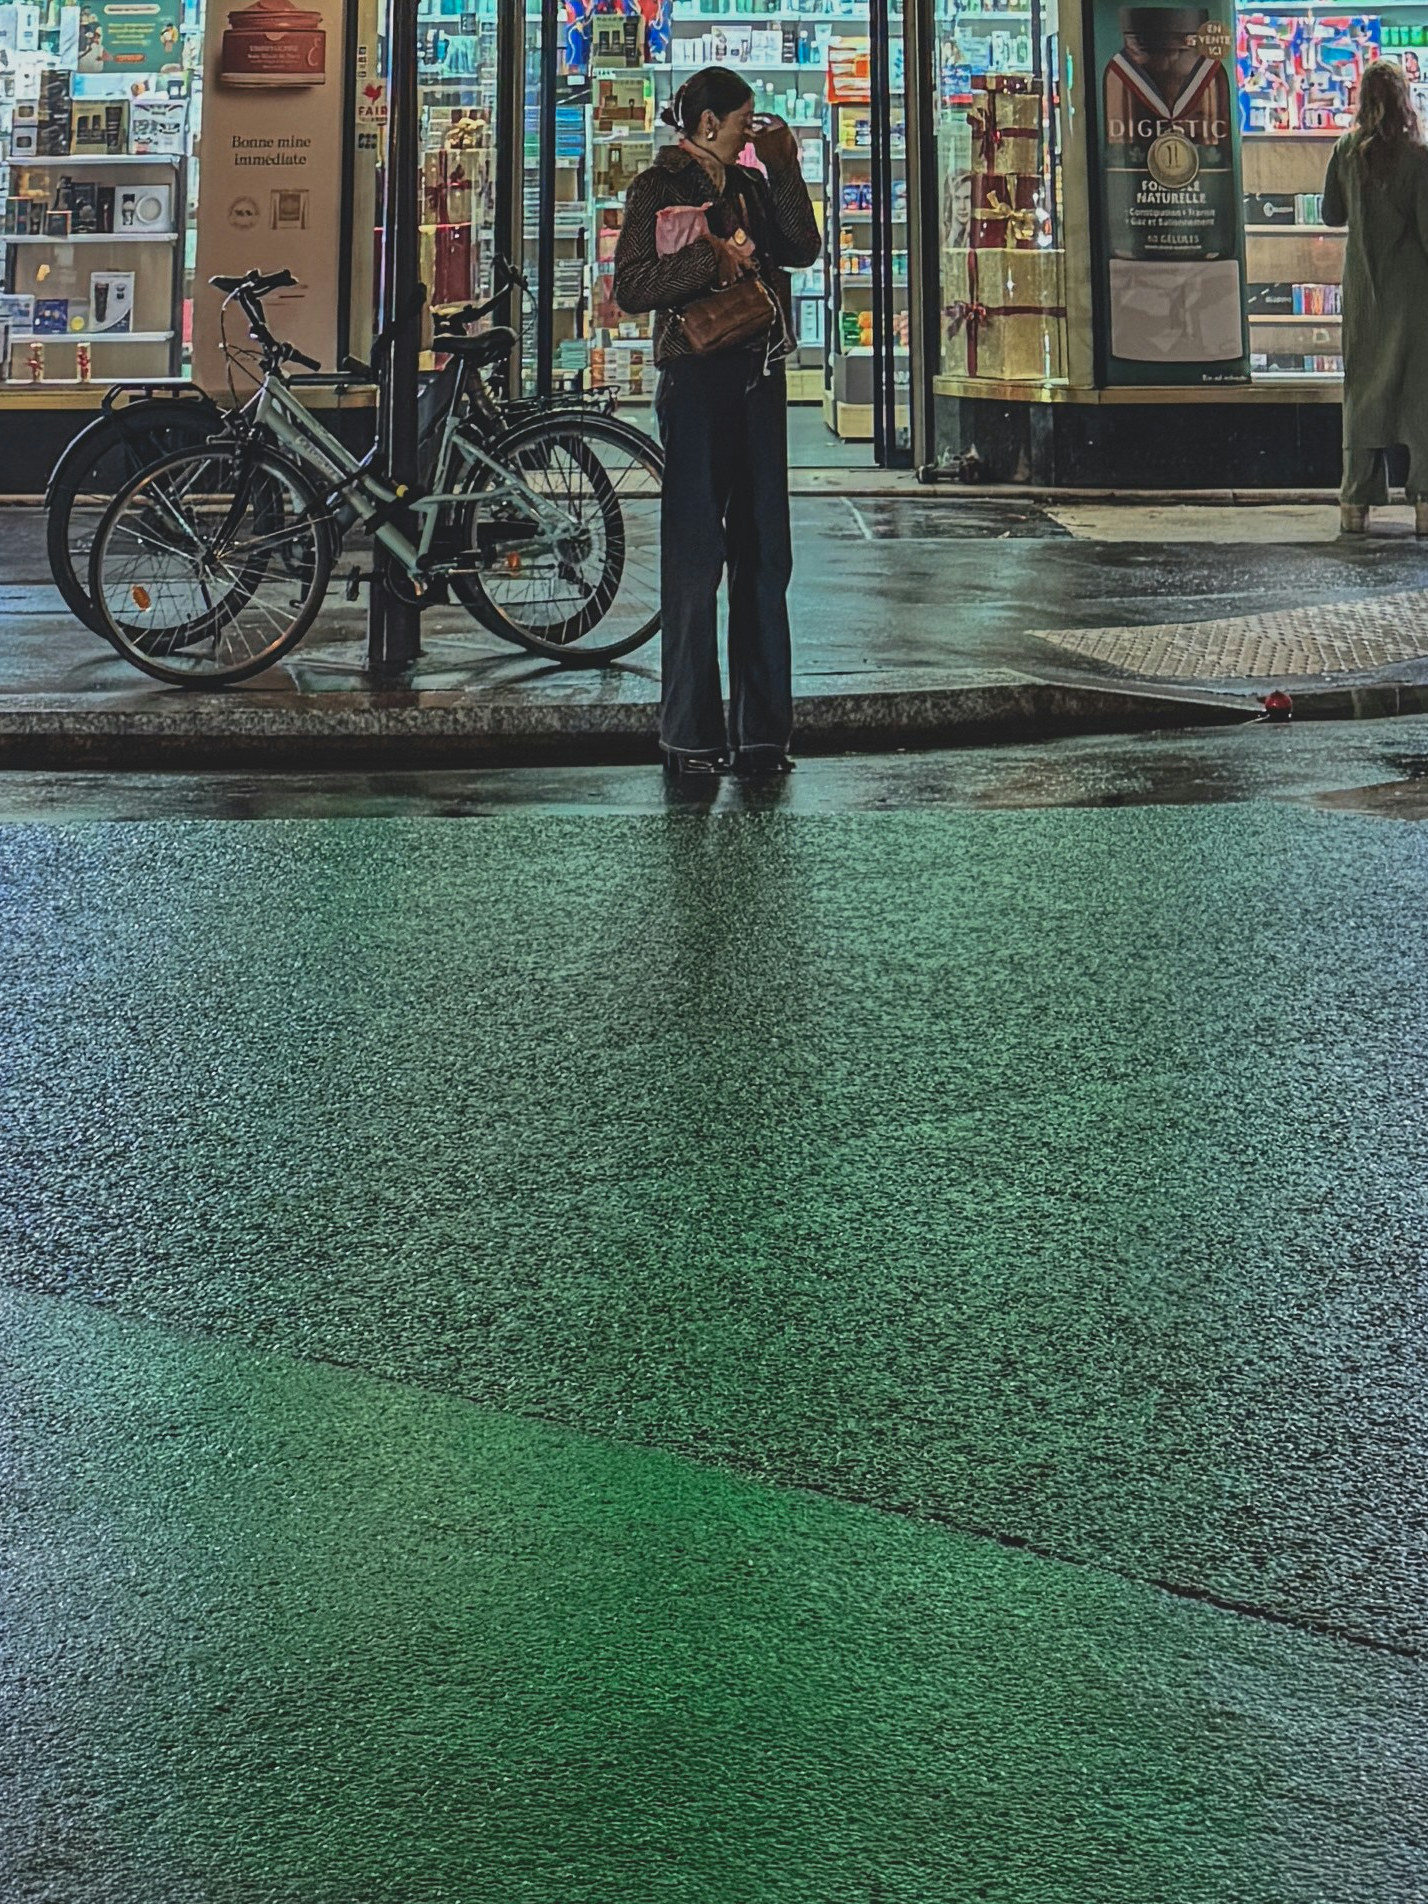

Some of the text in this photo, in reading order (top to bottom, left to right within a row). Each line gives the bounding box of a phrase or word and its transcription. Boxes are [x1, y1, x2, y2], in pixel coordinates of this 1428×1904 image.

[1206, 24, 1221, 33] EN
[1198, 35, 1231, 45] VENTE
[1108, 119, 1228, 138] DIGESTIC
[231, 135, 311, 149] Bonne mine
[234, 151, 307, 166] immédiate
[1136, 193, 1207, 204] NATURELLE
